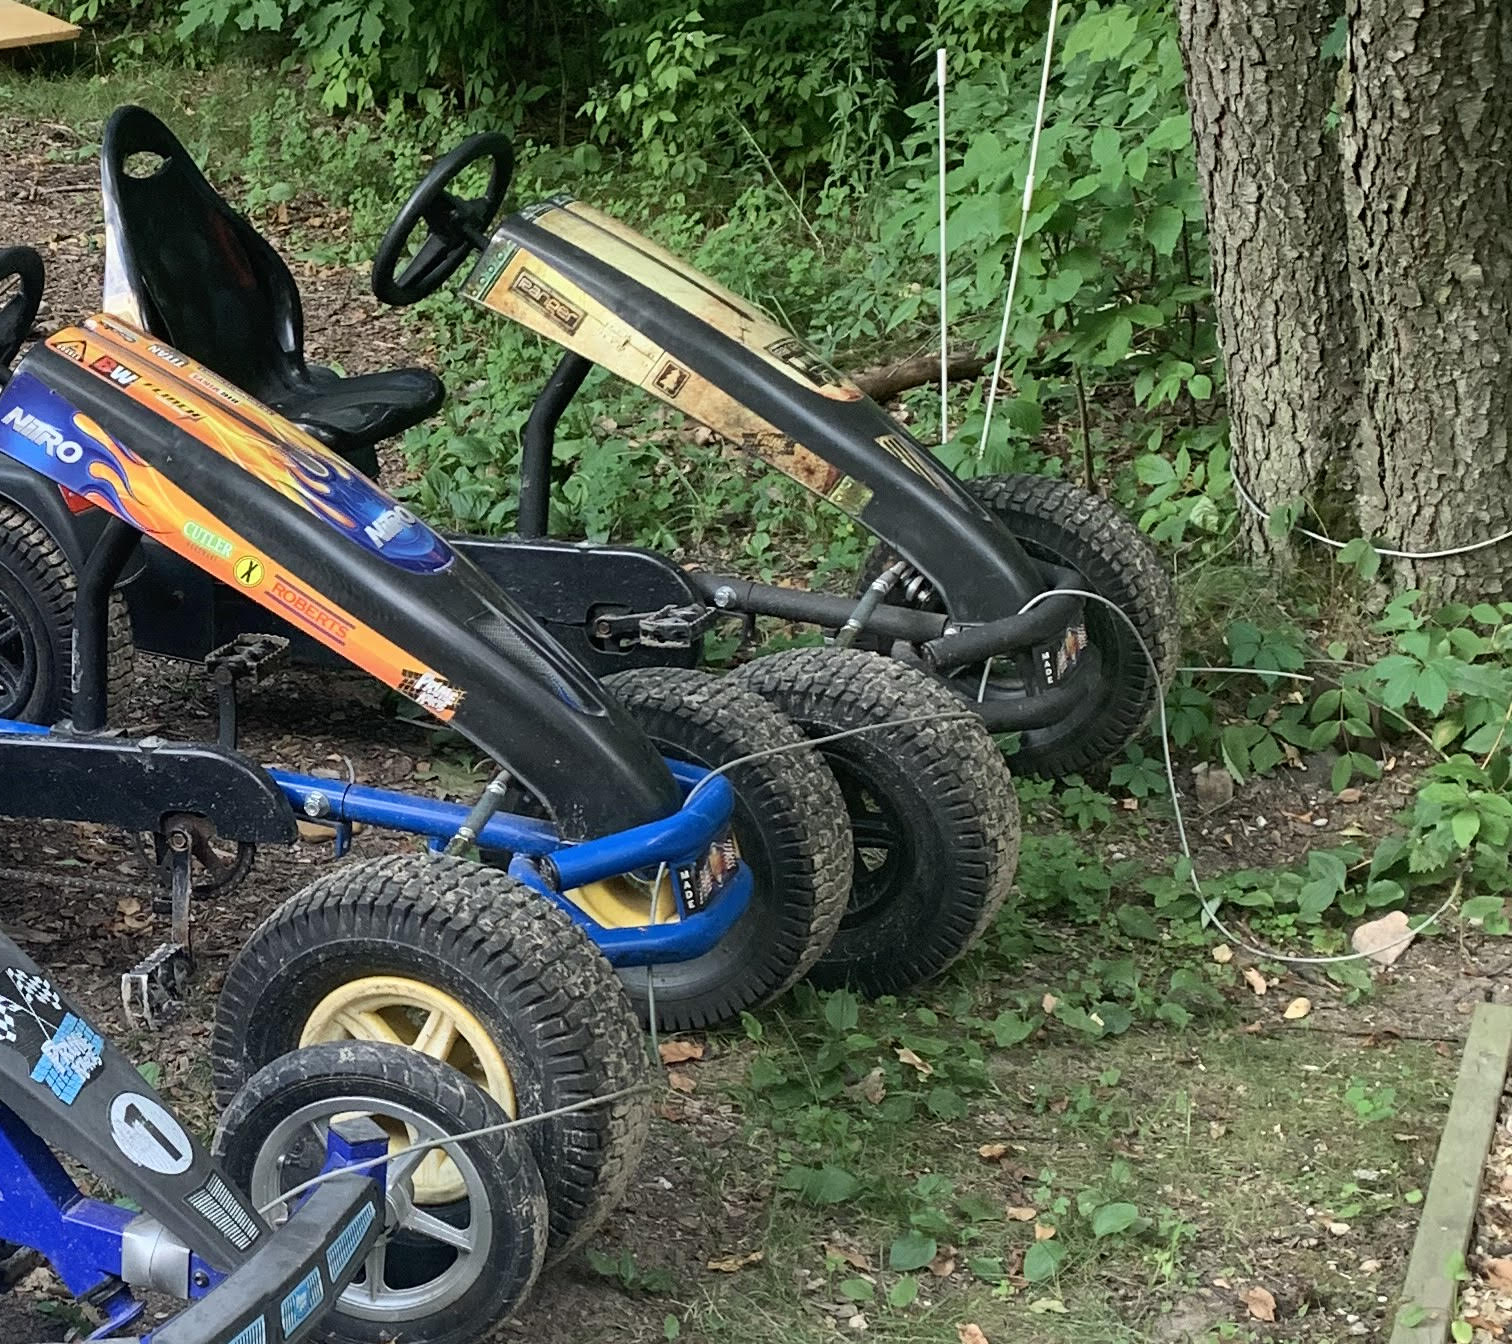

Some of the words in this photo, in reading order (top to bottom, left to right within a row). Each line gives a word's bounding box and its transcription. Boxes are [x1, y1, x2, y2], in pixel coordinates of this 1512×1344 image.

[183, 520, 234, 557] CUTLER
[271, 581, 351, 640] ROBERTS
[679, 869, 696, 910] MADE
[124, 1102, 184, 1163] 1
